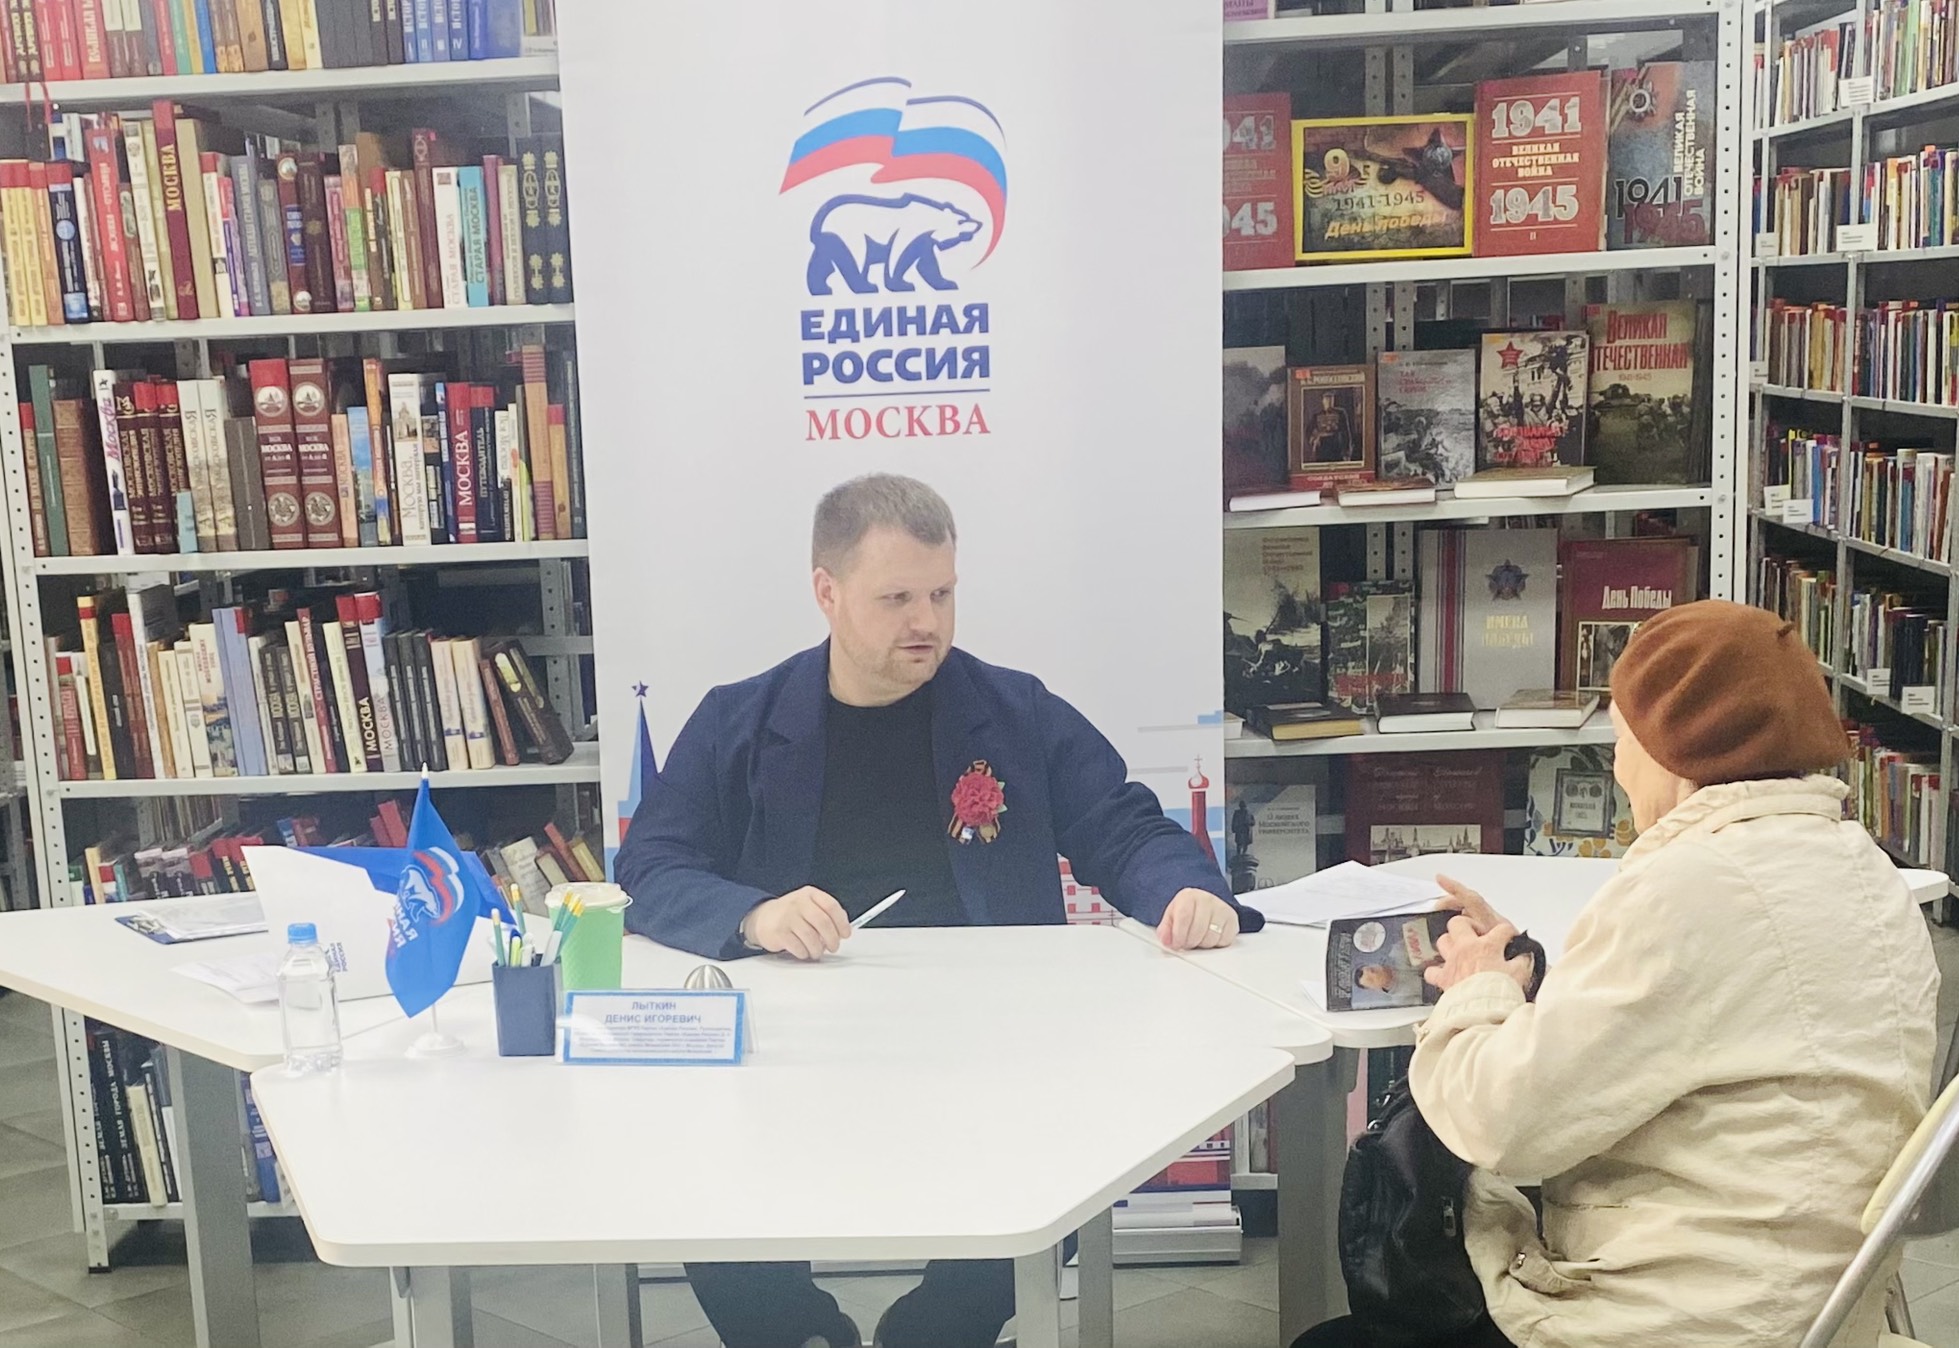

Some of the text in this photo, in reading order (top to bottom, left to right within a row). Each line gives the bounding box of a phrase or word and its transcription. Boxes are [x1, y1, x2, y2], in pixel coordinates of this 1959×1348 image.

[1223, 115, 1277, 150] 41
[1491, 96, 1582, 139] 1941
[1492, 153, 1580, 169] ОТЕЧЕСТВЕННАЯ
[1511, 142, 1560, 156] ВЕЛИКАЯ
[1673, 111, 1685, 173] ВЕЛИКАЯ
[1684, 89, 1696, 197] ОТЕЧЕСТВЕННАЯ
[161, 143, 182, 211] МОСКВА
[1323, 148, 1350, 180] 9
[1517, 165, 1553, 178] ВОЙНА
[1694, 147, 1706, 196] ВОЙНА
[468, 186, 480, 235] МОСКВА
[1334, 191, 1426, 212] 1941-1945
[1490, 185, 1579, 225] 1945
[1615, 176, 1685, 220] 1941
[1223, 201, 1278, 237] 45
[472, 239, 485, 284] СТАРАЯ
[800, 302, 990, 344] ЕДИНАЯ
[1606, 310, 1668, 344] ВЕЛИКАЯ
[802, 345, 990, 386] РОССИЯ
[805, 403, 991, 441] МОСКВА
[120, 430, 136, 499] МОСКОВСКАЯ
[141, 428, 157, 497] МОСКОВСКАЯ
[261, 442, 293, 453] МОСКВА
[298, 442, 330, 452] МОСКВА
[476, 427, 488, 498] ПУТЕВОДИТЕЛЬ
[455, 430, 473, 506] МОСКВА
[1602, 585, 1673, 610] День Победы
[1485, 614, 1528, 630] ИМЕНА
[306, 652, 323, 701] СТРАСТНОЙ
[358, 696, 378, 752] МОСКВА
[379, 697, 393, 751] МОСКВА
[604, 1013, 701, 1025] ДЕНИС ИГОРЕВИЧ
[631, 1001, 677, 1011] ЛЫТКИН
[101, 1039, 128, 1149] ЗЕМЛЯ ГОРОДА МОСКВЫ
